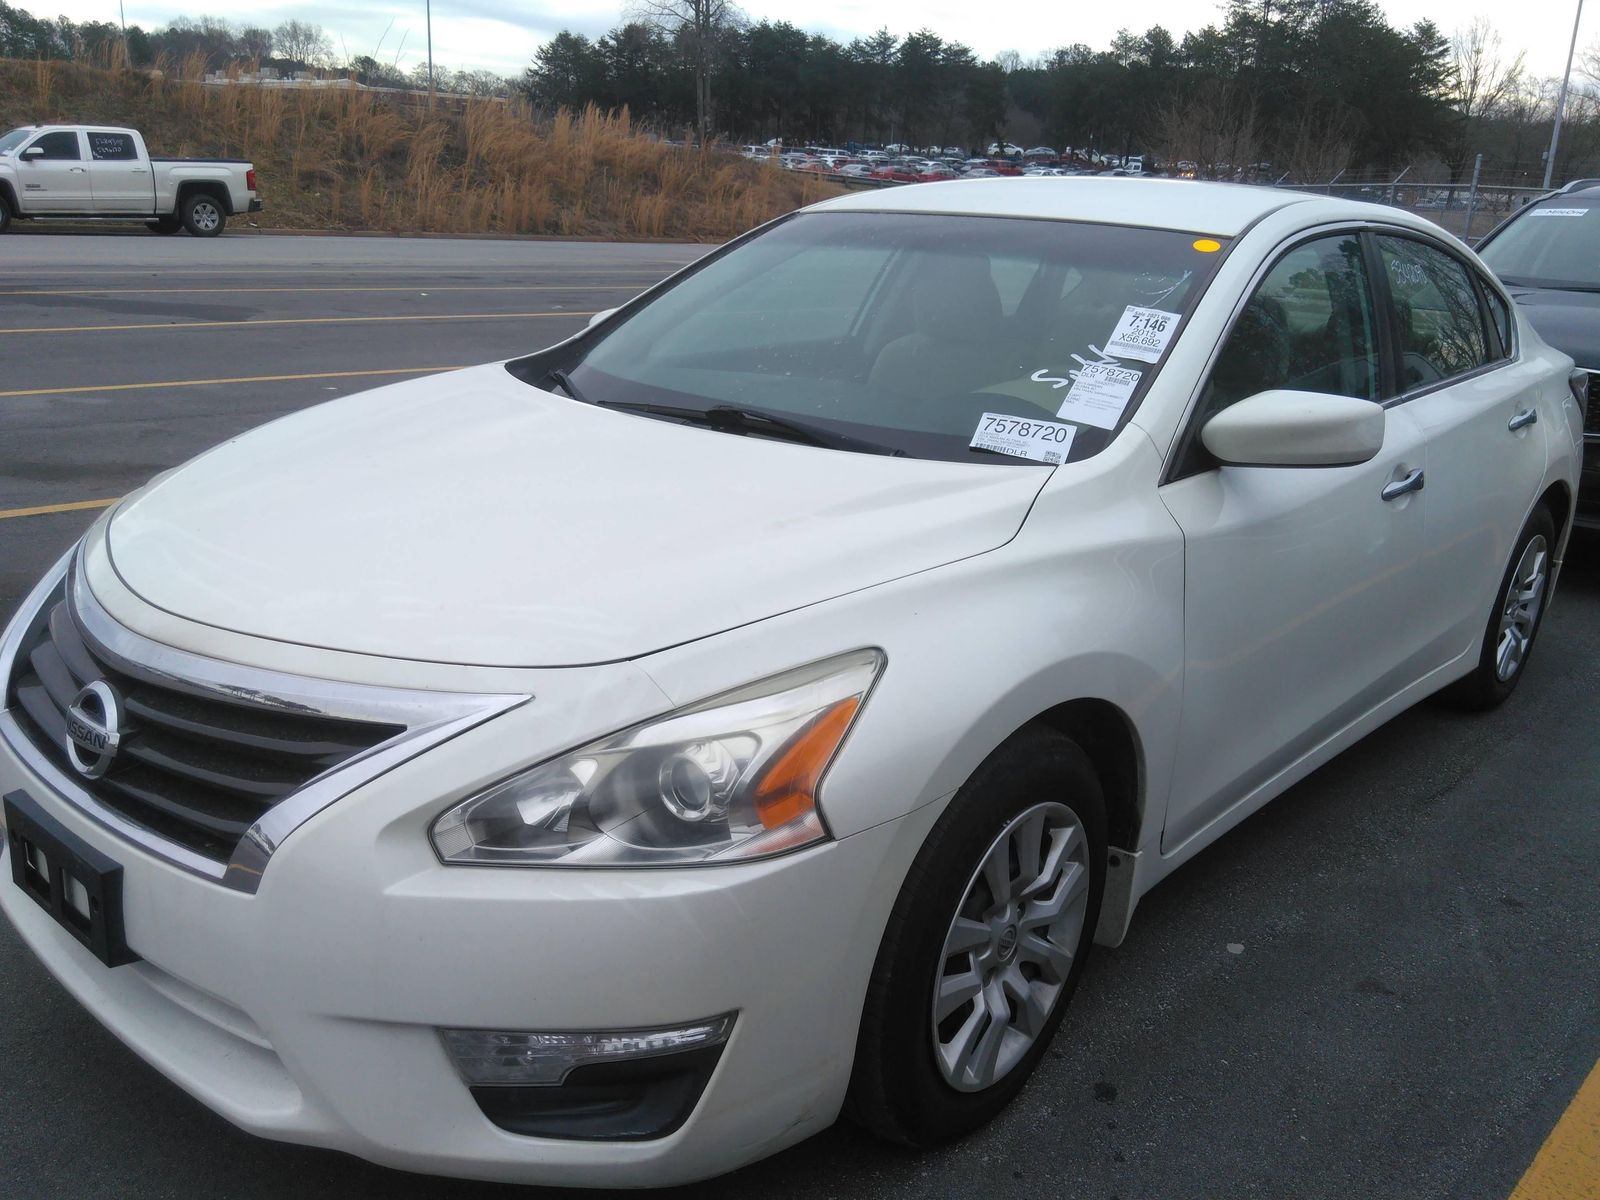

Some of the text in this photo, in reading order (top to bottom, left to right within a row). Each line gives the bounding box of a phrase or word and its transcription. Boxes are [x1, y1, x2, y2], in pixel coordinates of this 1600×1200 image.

[1129, 315, 1167, 332] 7:146
[1131, 327, 1157, 338] 2015
[1083, 363, 1140, 381] 7578720
[983, 417, 1067, 443] 7578720
[1006, 447, 1028, 457] DLR
